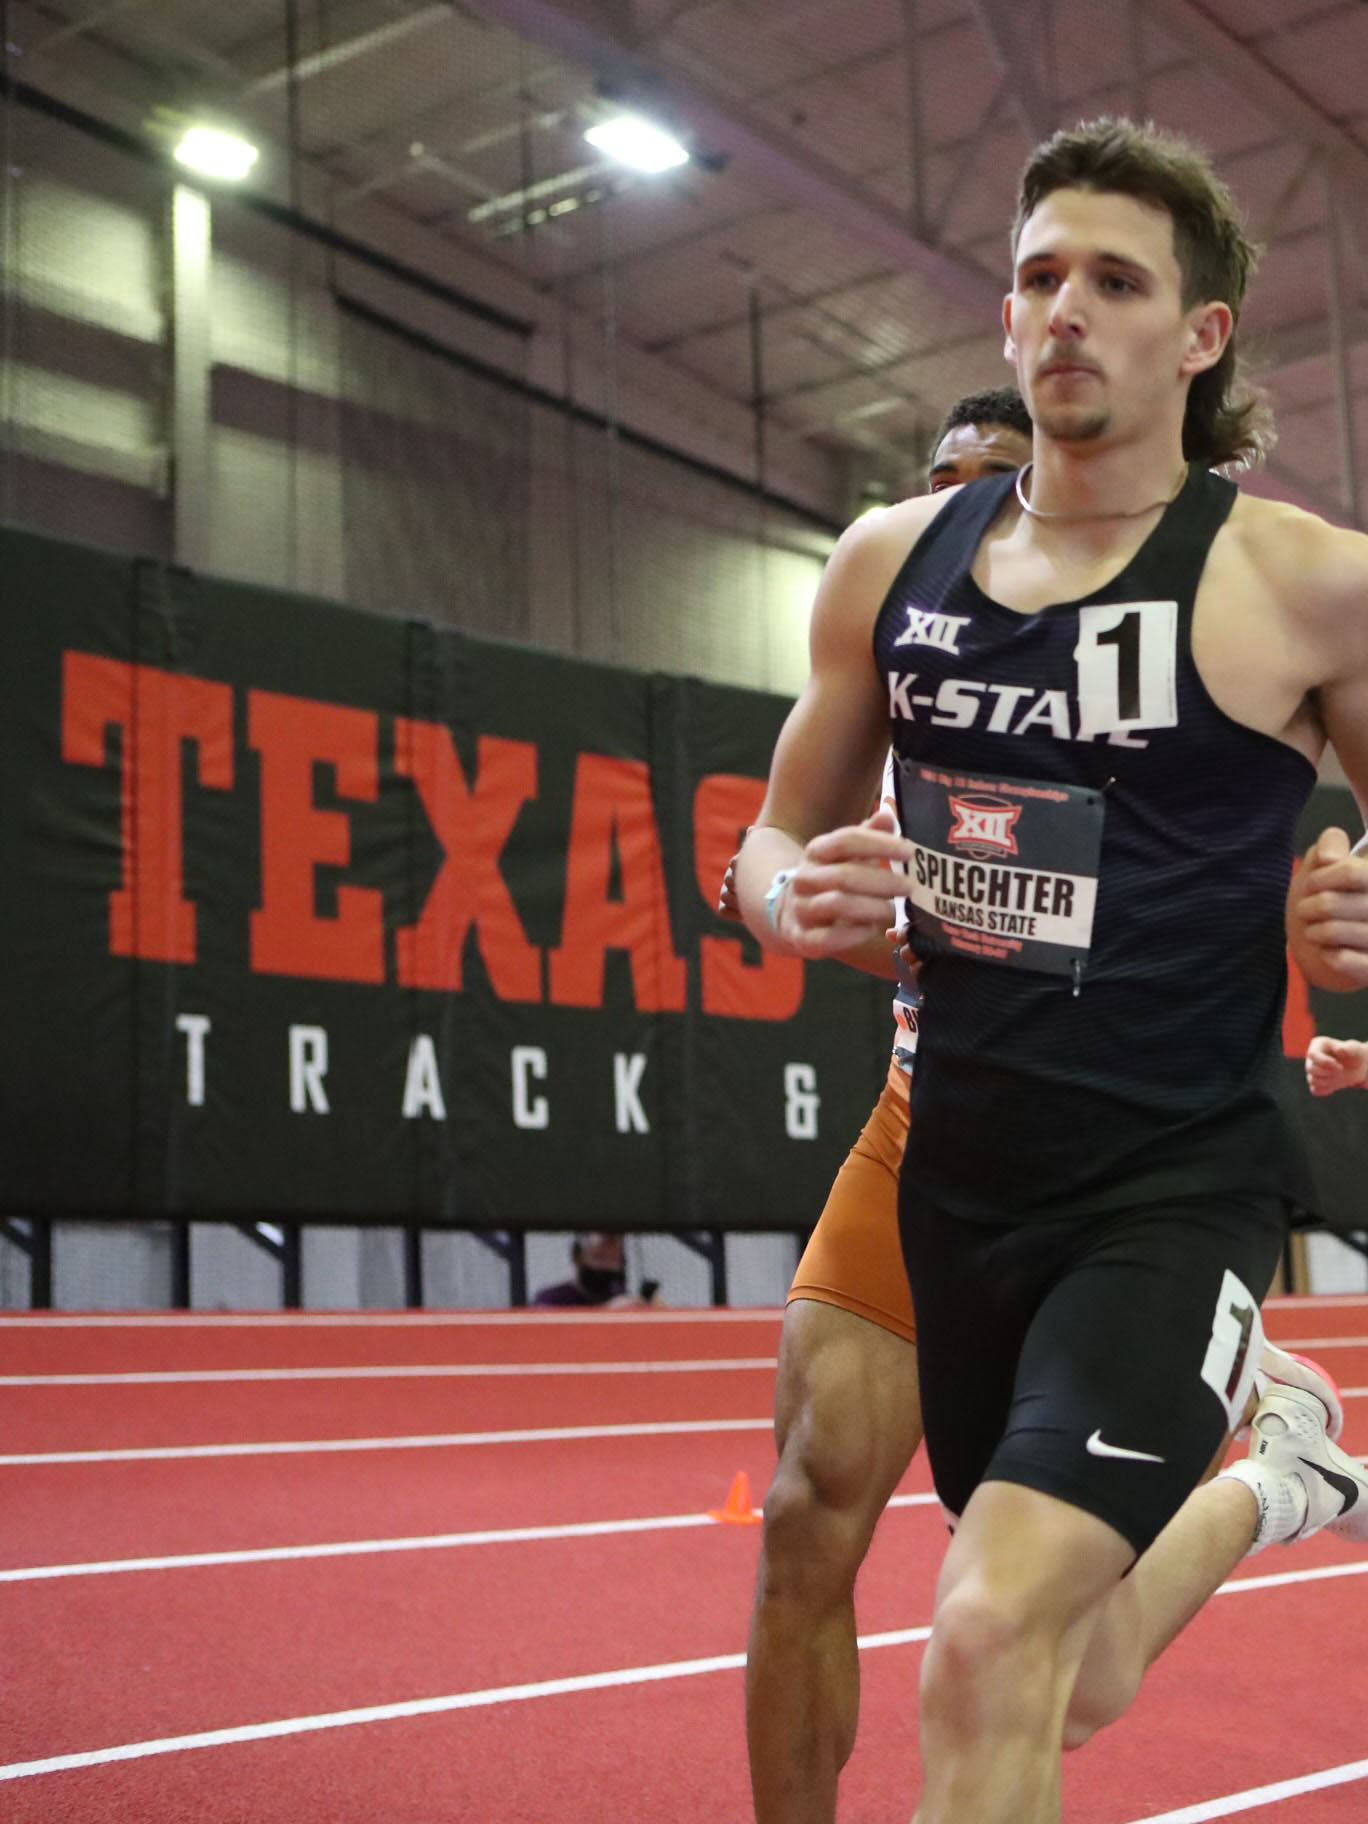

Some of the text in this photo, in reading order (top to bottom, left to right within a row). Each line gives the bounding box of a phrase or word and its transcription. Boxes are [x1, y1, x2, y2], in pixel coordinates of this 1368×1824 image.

[893, 606, 971, 656] XII
[1096, 611, 1141, 720] 1
[888, 671, 1149, 749] K-STA
[61, 650, 804, 1022] TEXAS
[953, 804, 1017, 848] XII
[914, 848, 1075, 918] SPLECHTER
[935, 896, 1037, 937] KANSAS STATE
[176, 1014, 821, 1140] TRACK &
